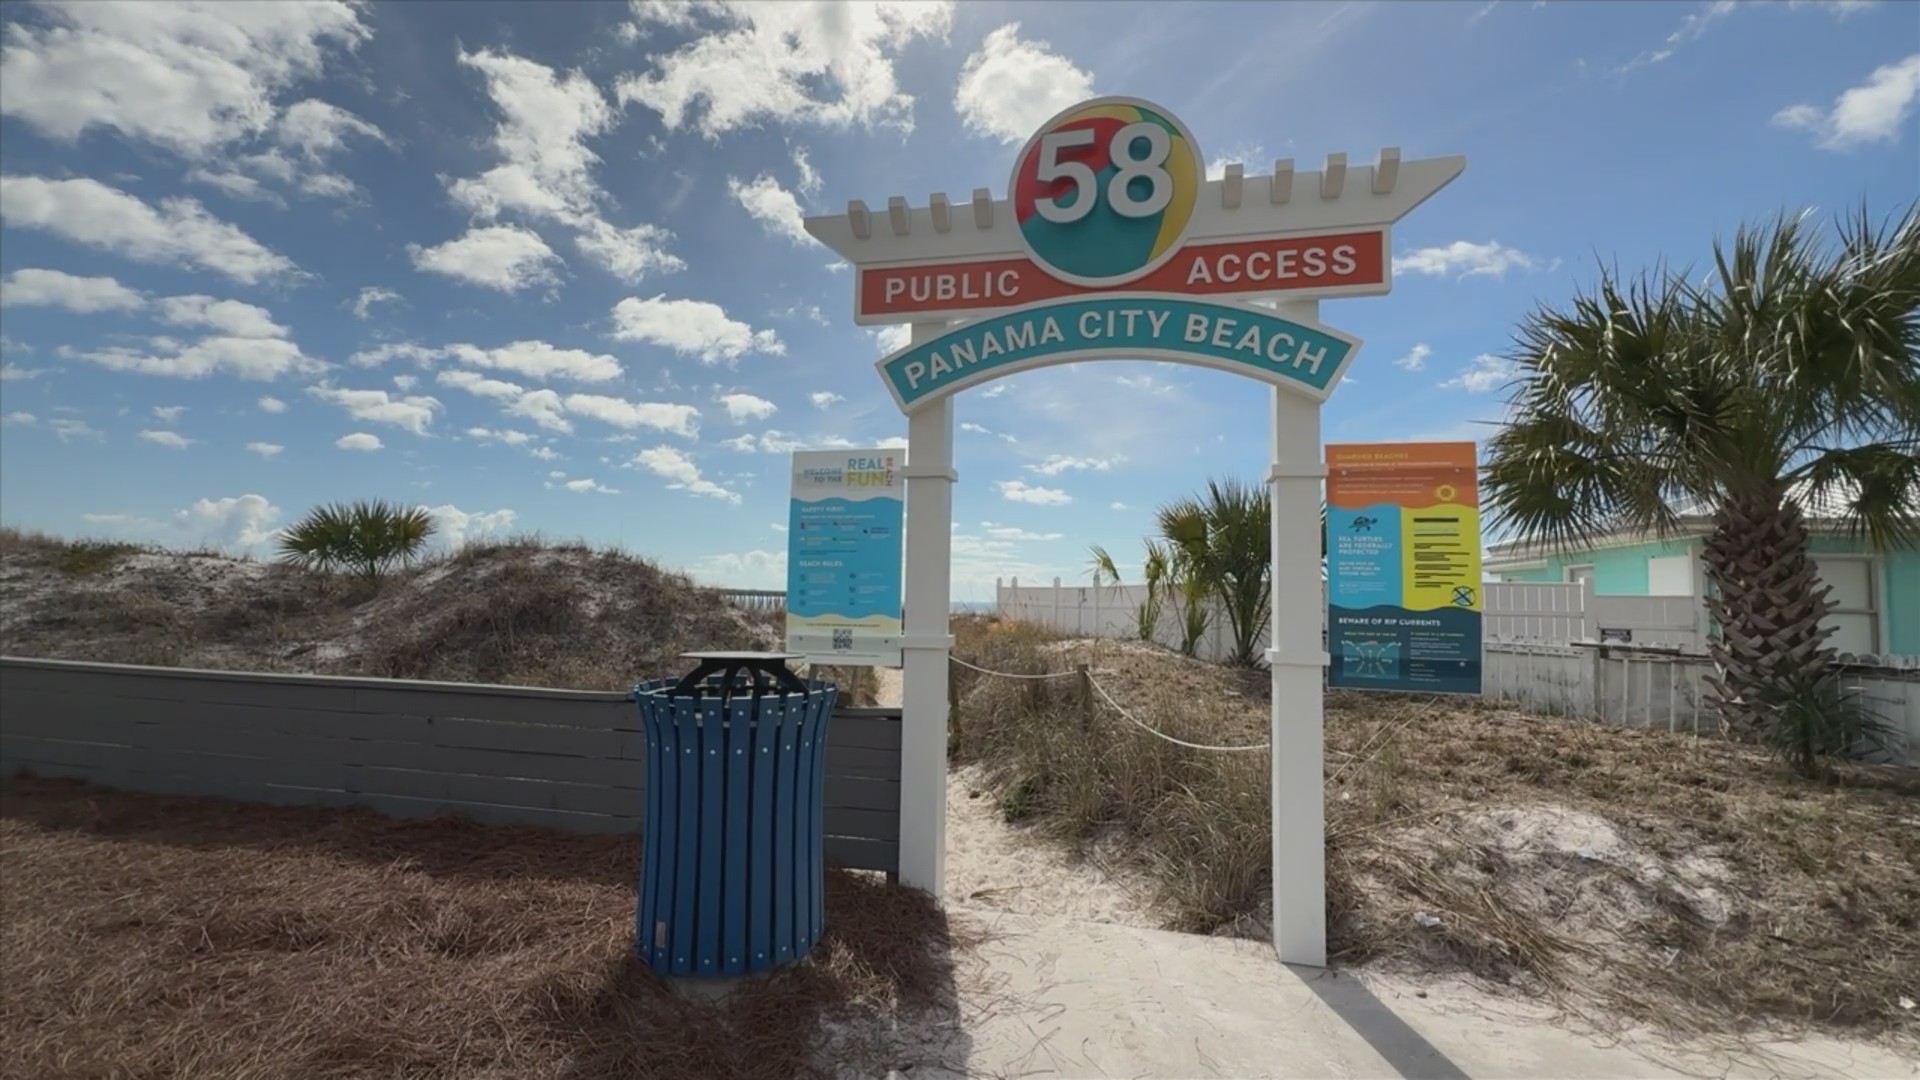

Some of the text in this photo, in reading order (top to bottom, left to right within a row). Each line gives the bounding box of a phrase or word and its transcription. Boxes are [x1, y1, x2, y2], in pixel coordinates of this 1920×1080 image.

[1033, 121, 1174, 225] 58
[884, 244, 1358, 303] PUBLIC ACCESS
[903, 309, 1328, 390] PANAMA CITY BEACH
[803, 467, 843, 476] WELCOME
[847, 458, 884, 470] REAL
[847, 471, 884, 487] FUN
[1338, 617, 1369, 625] BEWARE
[1384, 618, 1397, 626] RIP
[1399, 618, 1441, 627] CURRENTS
